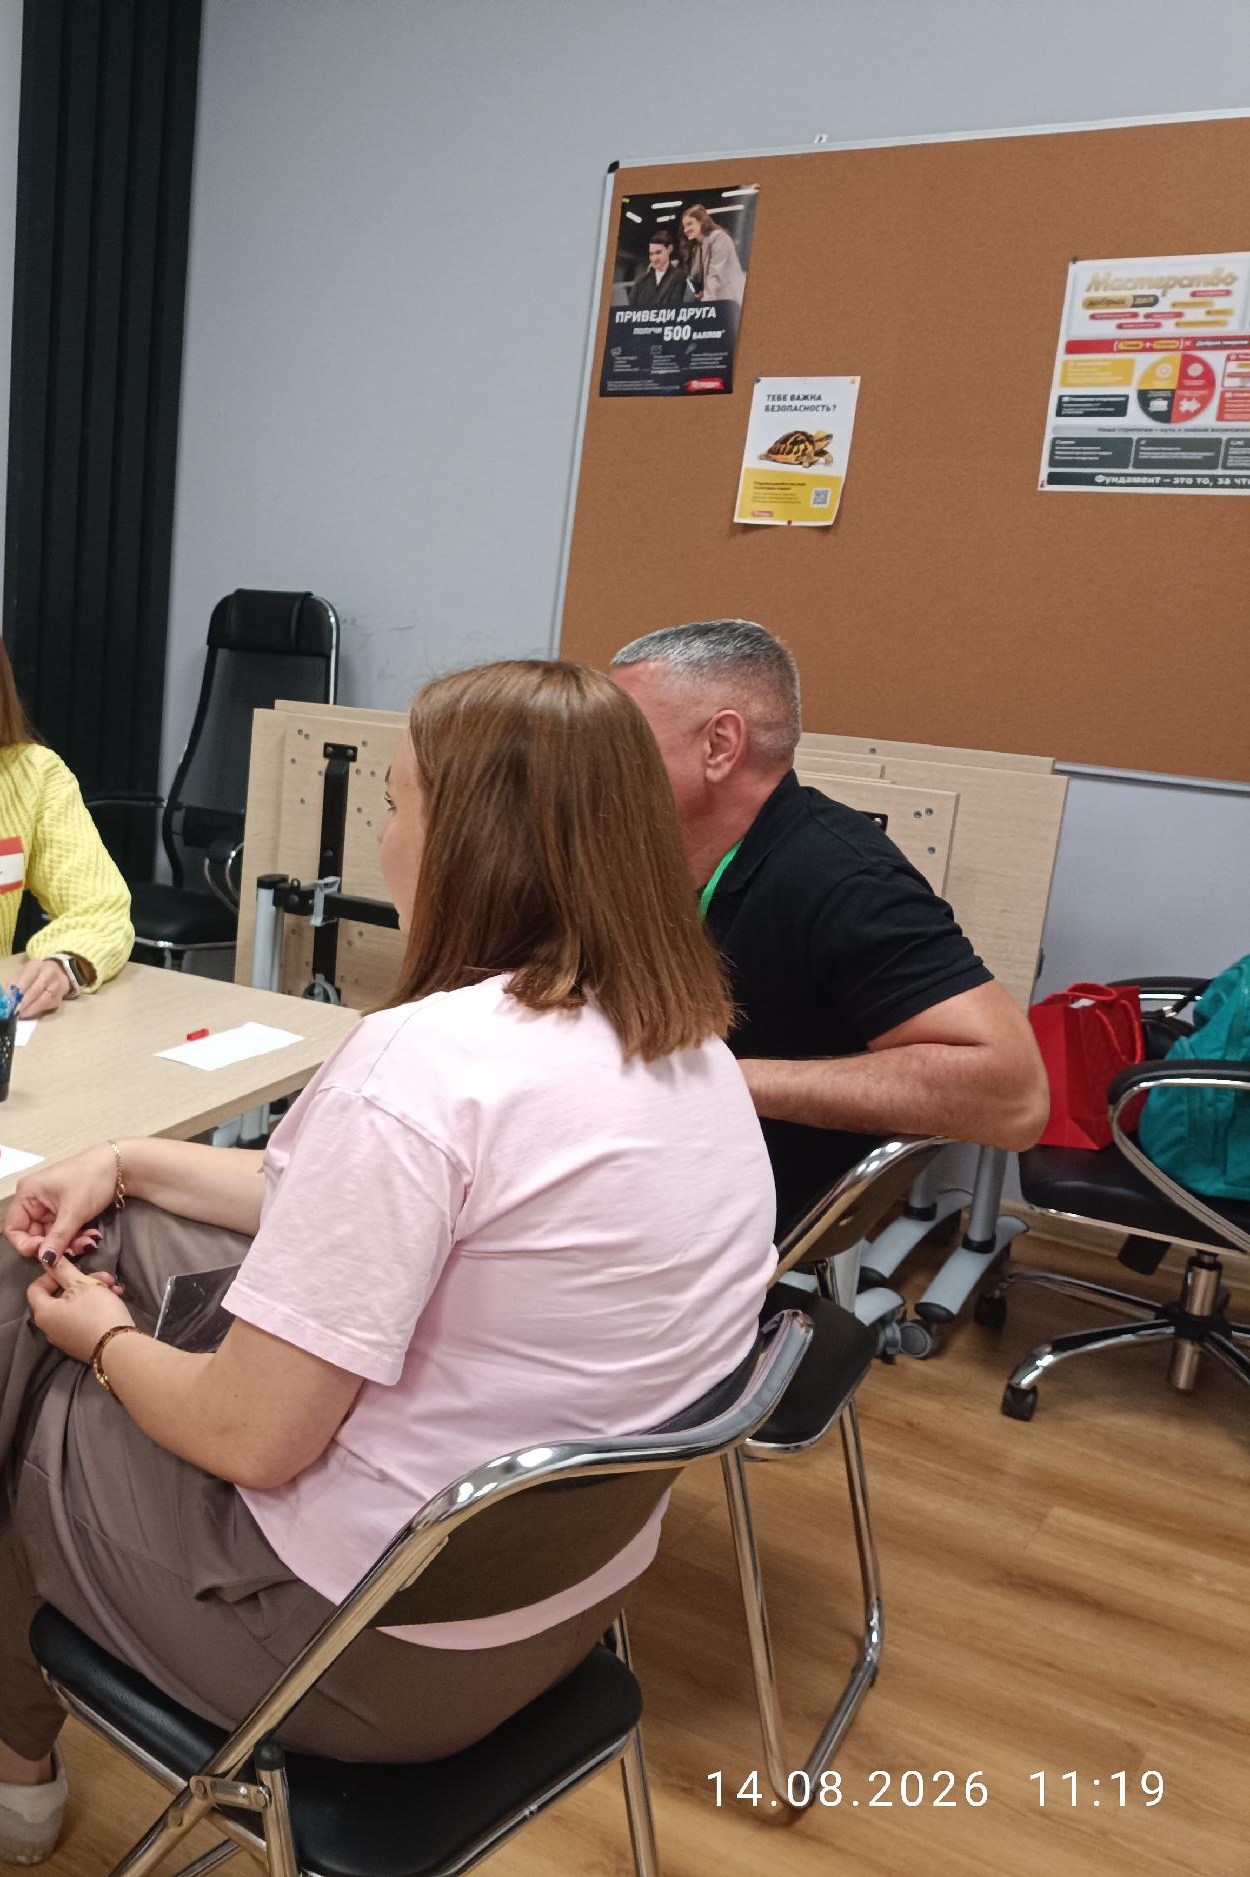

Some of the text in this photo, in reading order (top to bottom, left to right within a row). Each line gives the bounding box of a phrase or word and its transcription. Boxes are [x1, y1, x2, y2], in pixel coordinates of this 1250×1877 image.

[615, 306, 717, 323] ПРИВЕДИ ДРУГА
[663, 325, 692, 341] 500
[766, 394, 822, 402] ТЕБЕ ВАЖНА
[1094, 474, 1161, 484] Фундамент
